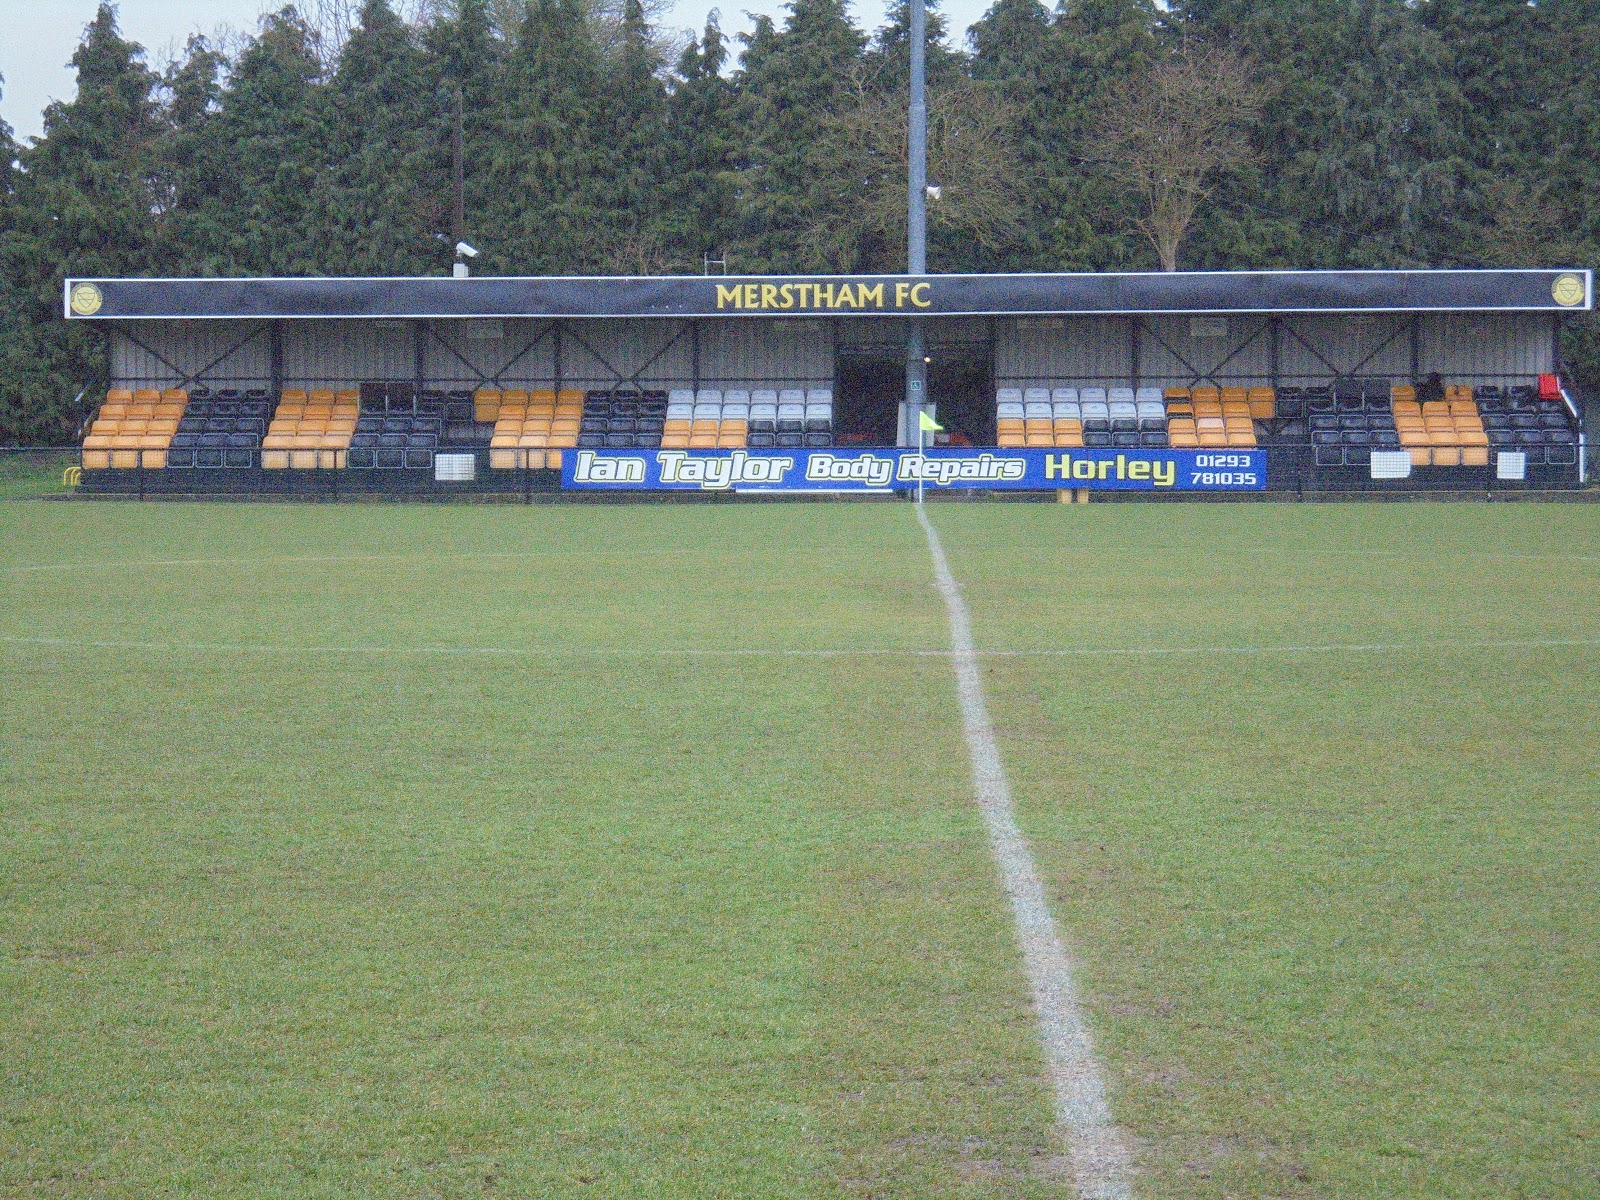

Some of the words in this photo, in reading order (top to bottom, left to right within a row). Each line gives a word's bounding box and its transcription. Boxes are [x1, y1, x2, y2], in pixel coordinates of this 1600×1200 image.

[715, 283, 884, 309] MERSTHAM
[895, 282, 931, 307] FC
[574, 451, 645, 483] Ian
[657, 451, 791, 489] Taylor
[806, 455, 893, 484] Body
[897, 454, 1026, 485] Repairs
[1045, 454, 1175, 486] Horley
[1196, 455, 1250, 468] 01293
[1191, 472, 1256, 486] 781035
